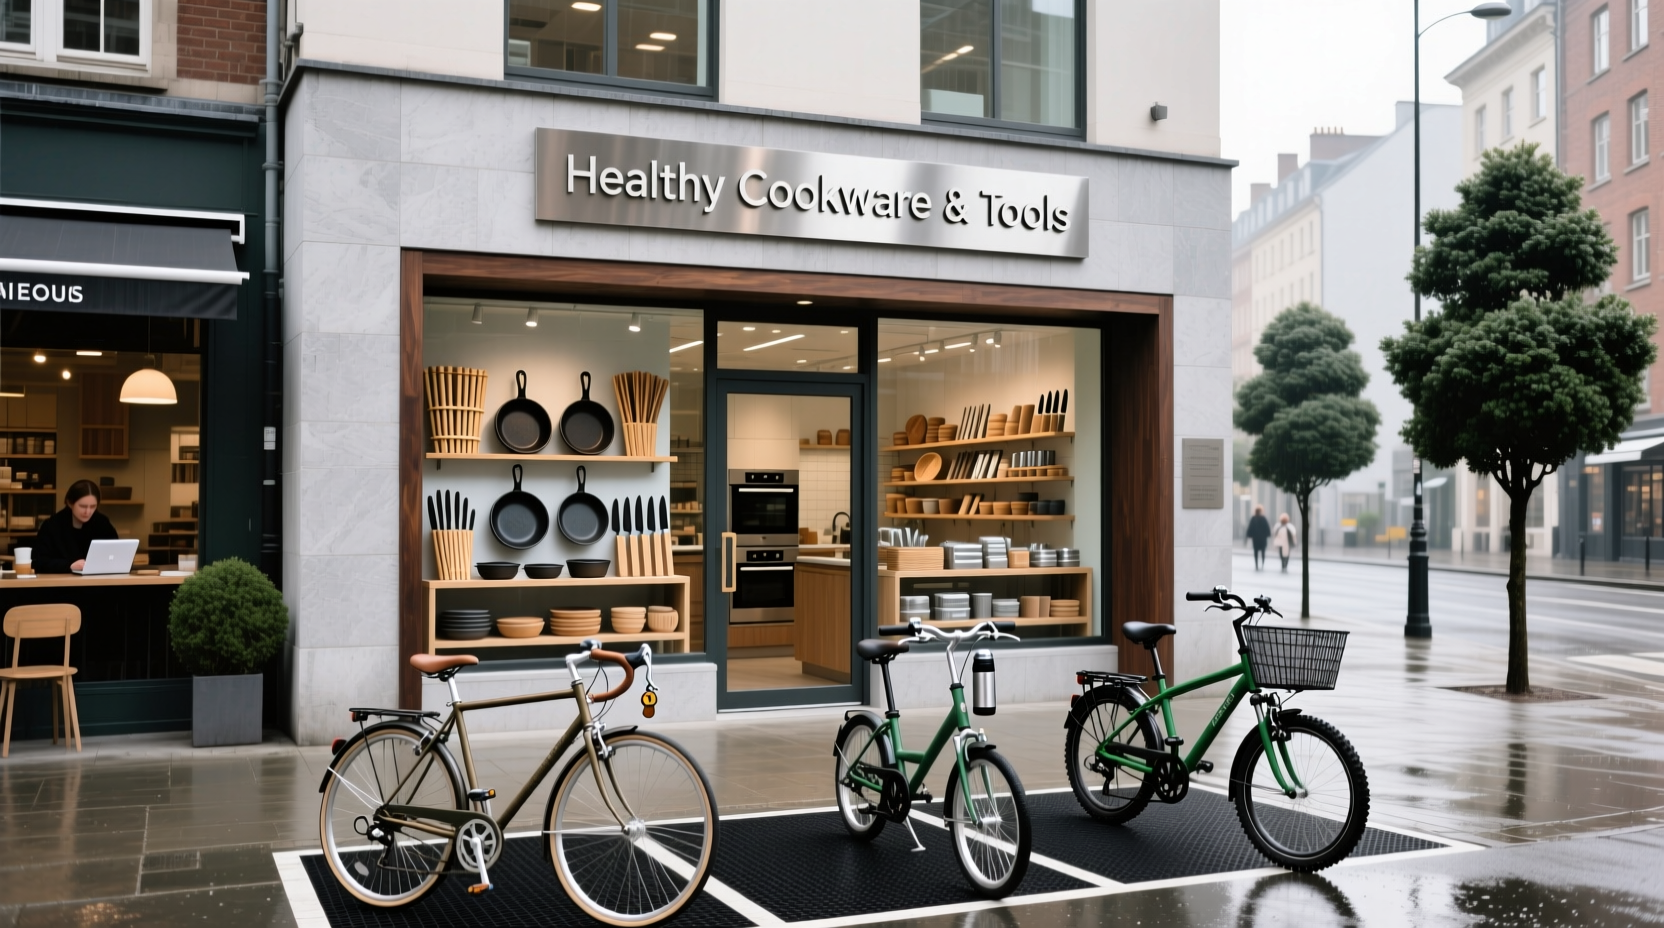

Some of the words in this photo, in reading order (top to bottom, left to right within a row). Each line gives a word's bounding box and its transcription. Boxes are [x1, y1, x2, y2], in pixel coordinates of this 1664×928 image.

[567, 153, 726, 213] Healthy
[738, 168, 932, 220] Cookware
[943, 187, 969, 225] &
[979, 190, 1071, 233] Tools
